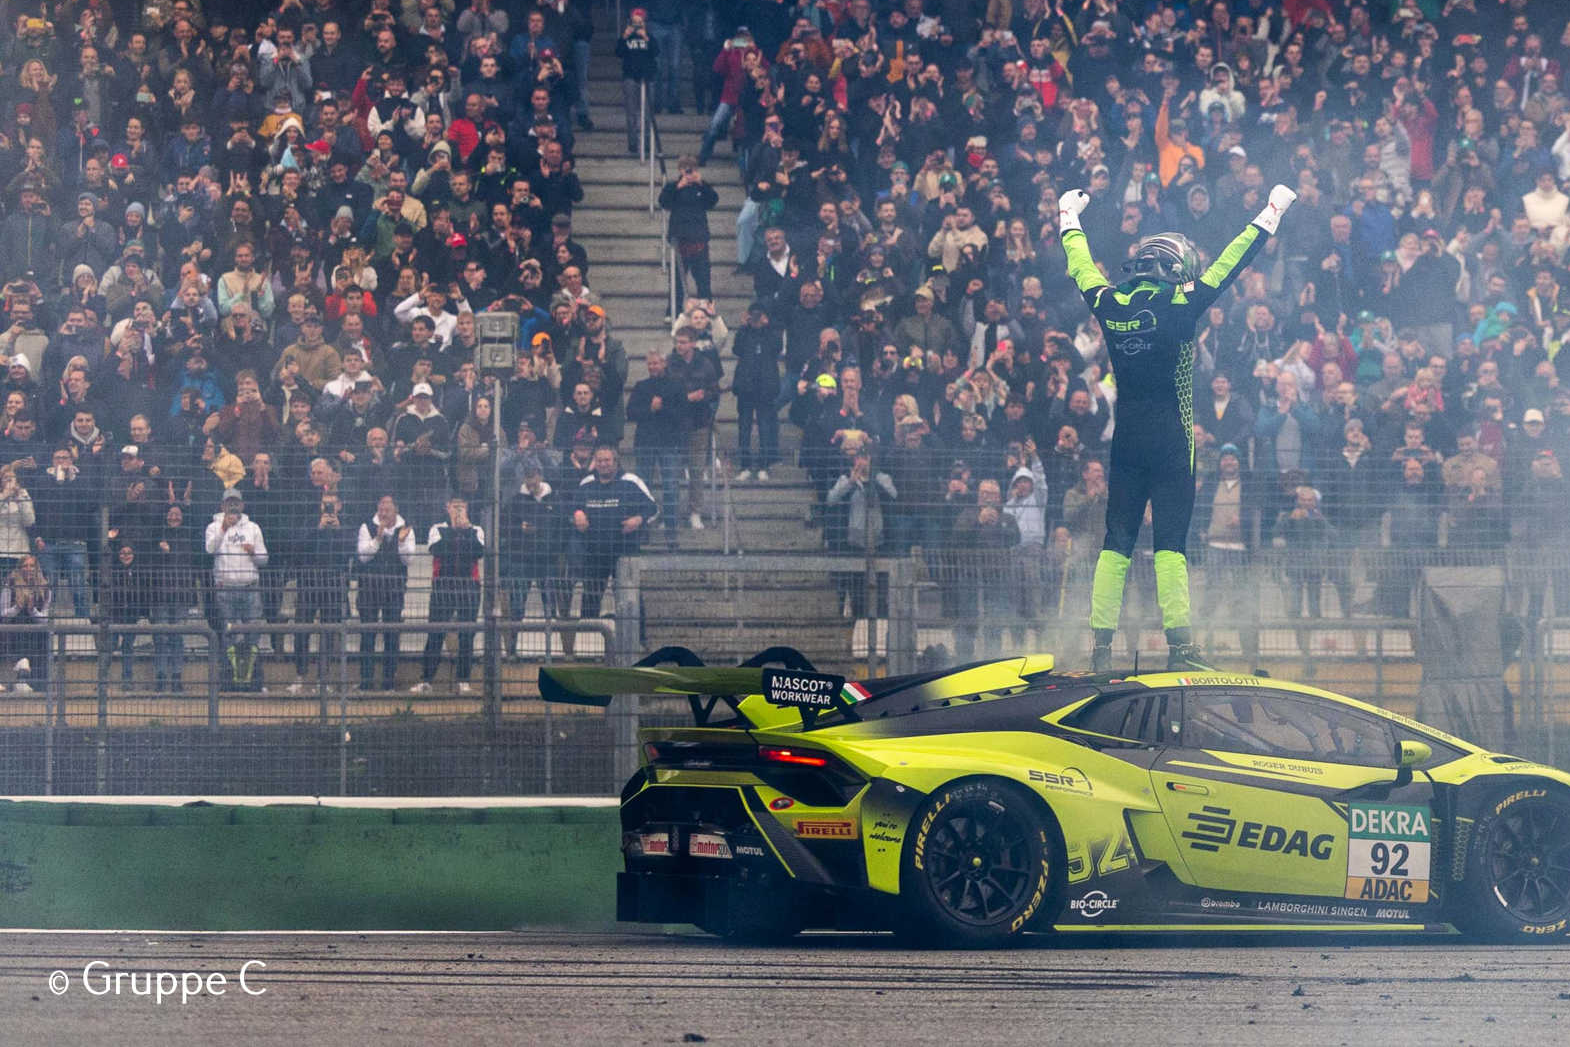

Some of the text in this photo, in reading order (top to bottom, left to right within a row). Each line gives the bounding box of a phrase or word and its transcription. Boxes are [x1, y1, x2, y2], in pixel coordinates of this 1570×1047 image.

[1105, 319, 1140, 331] SSR
[1191, 677, 1260, 685] BORTOLOTTI
[771, 690, 831, 704] WORKWEAR
[1028, 769, 1074, 786] SSR
[1496, 789, 1547, 815] PIRELLI
[796, 820, 852, 835] PIRELLI
[1351, 808, 1429, 836] DEKRA
[914, 793, 950, 870] PIRELLI
[1237, 821, 1336, 861] EDAG
[736, 845, 764, 857] MOTUL
[1371, 842, 1410, 877] 92
[1360, 878, 1413, 901] ADAC
[1070, 899, 1119, 910] BIO-CIRCLE
[1257, 901, 1368, 918] LAMBORGHINI SINGEN
[1376, 908, 1410, 919] MOTUL
